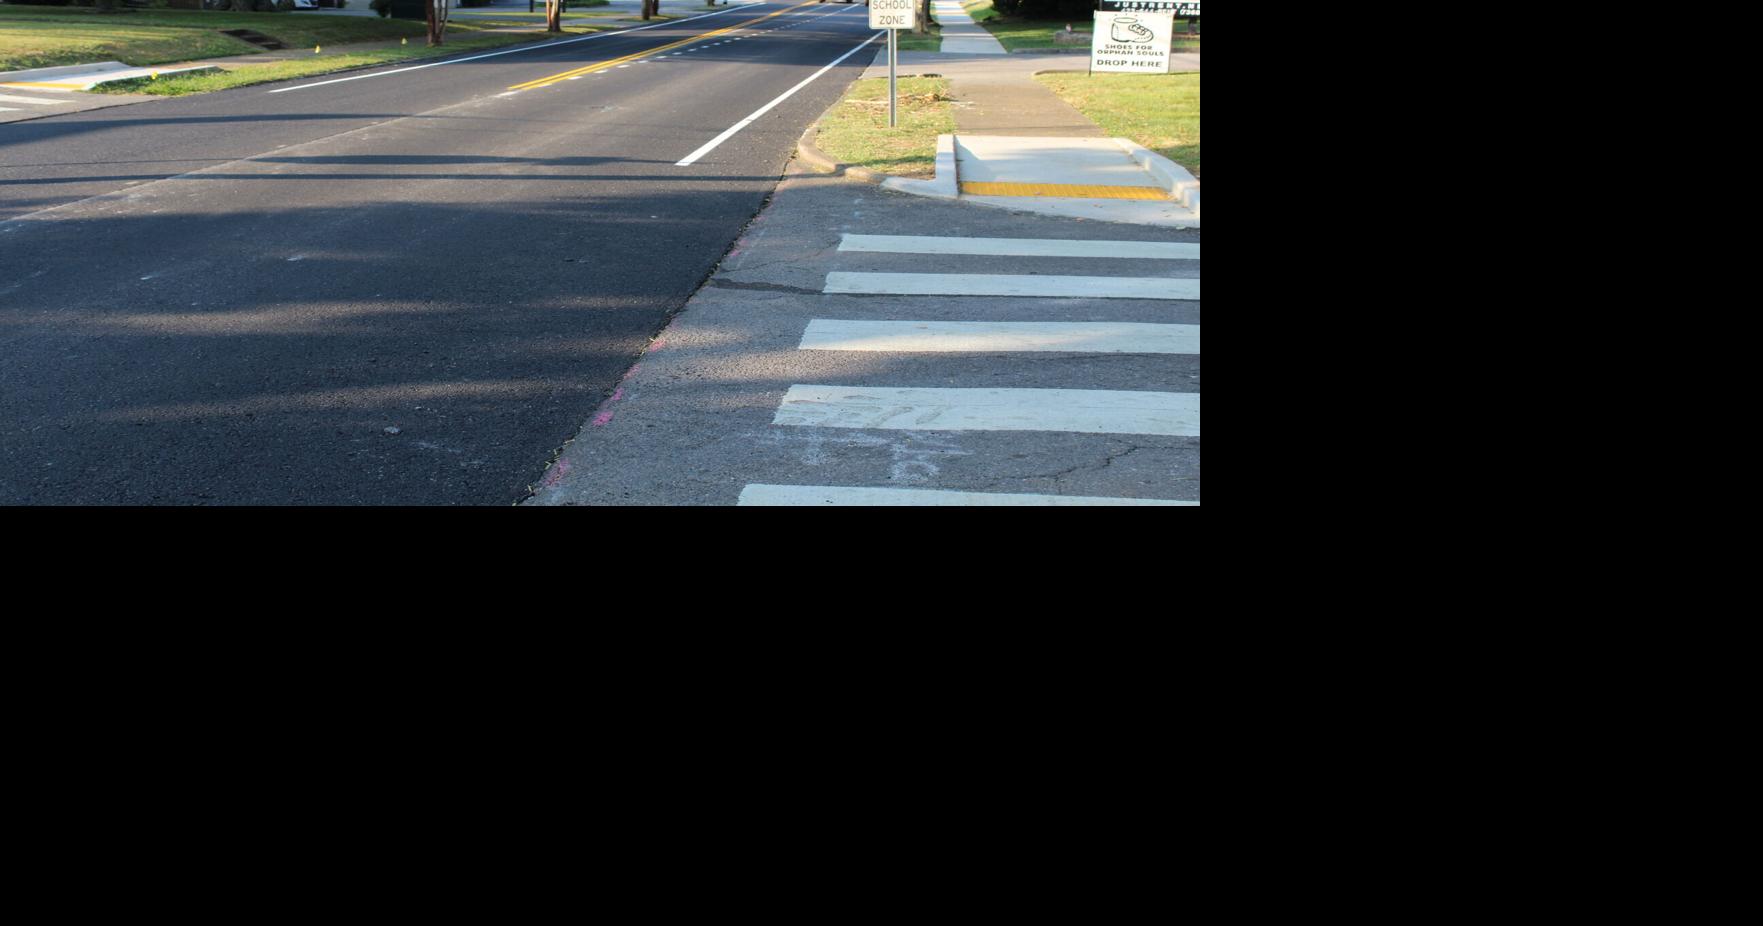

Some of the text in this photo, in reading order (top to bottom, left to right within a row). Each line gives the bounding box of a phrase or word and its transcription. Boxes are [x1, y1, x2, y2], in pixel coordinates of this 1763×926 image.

[872, 0, 912, 10] SCHOOL
[879, 15, 906, 25] ZONE
[1131, 60, 1163, 68] HERE
